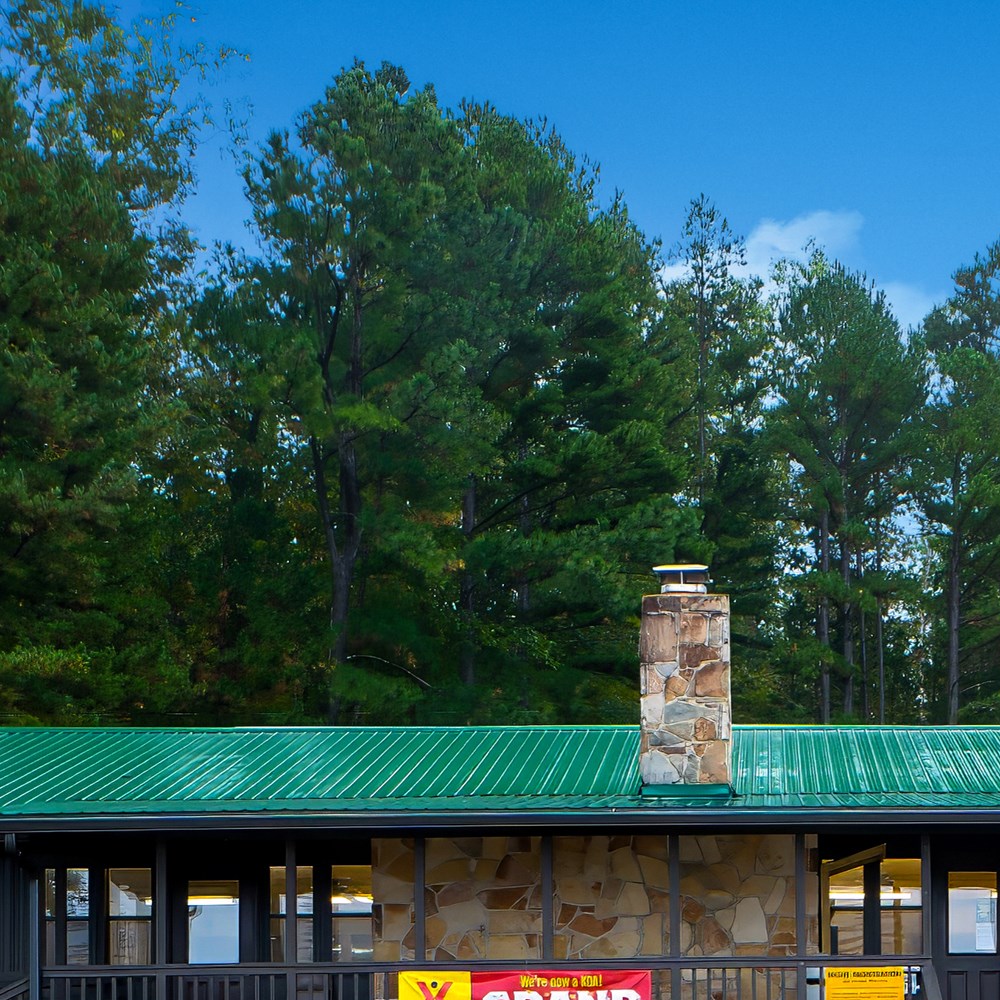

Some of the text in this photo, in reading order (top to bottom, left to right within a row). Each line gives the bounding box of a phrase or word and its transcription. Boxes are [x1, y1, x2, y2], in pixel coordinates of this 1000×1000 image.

[520, 975, 548, 988] We're
[550, 977, 570, 988] now
[572, 978, 579, 988] a
